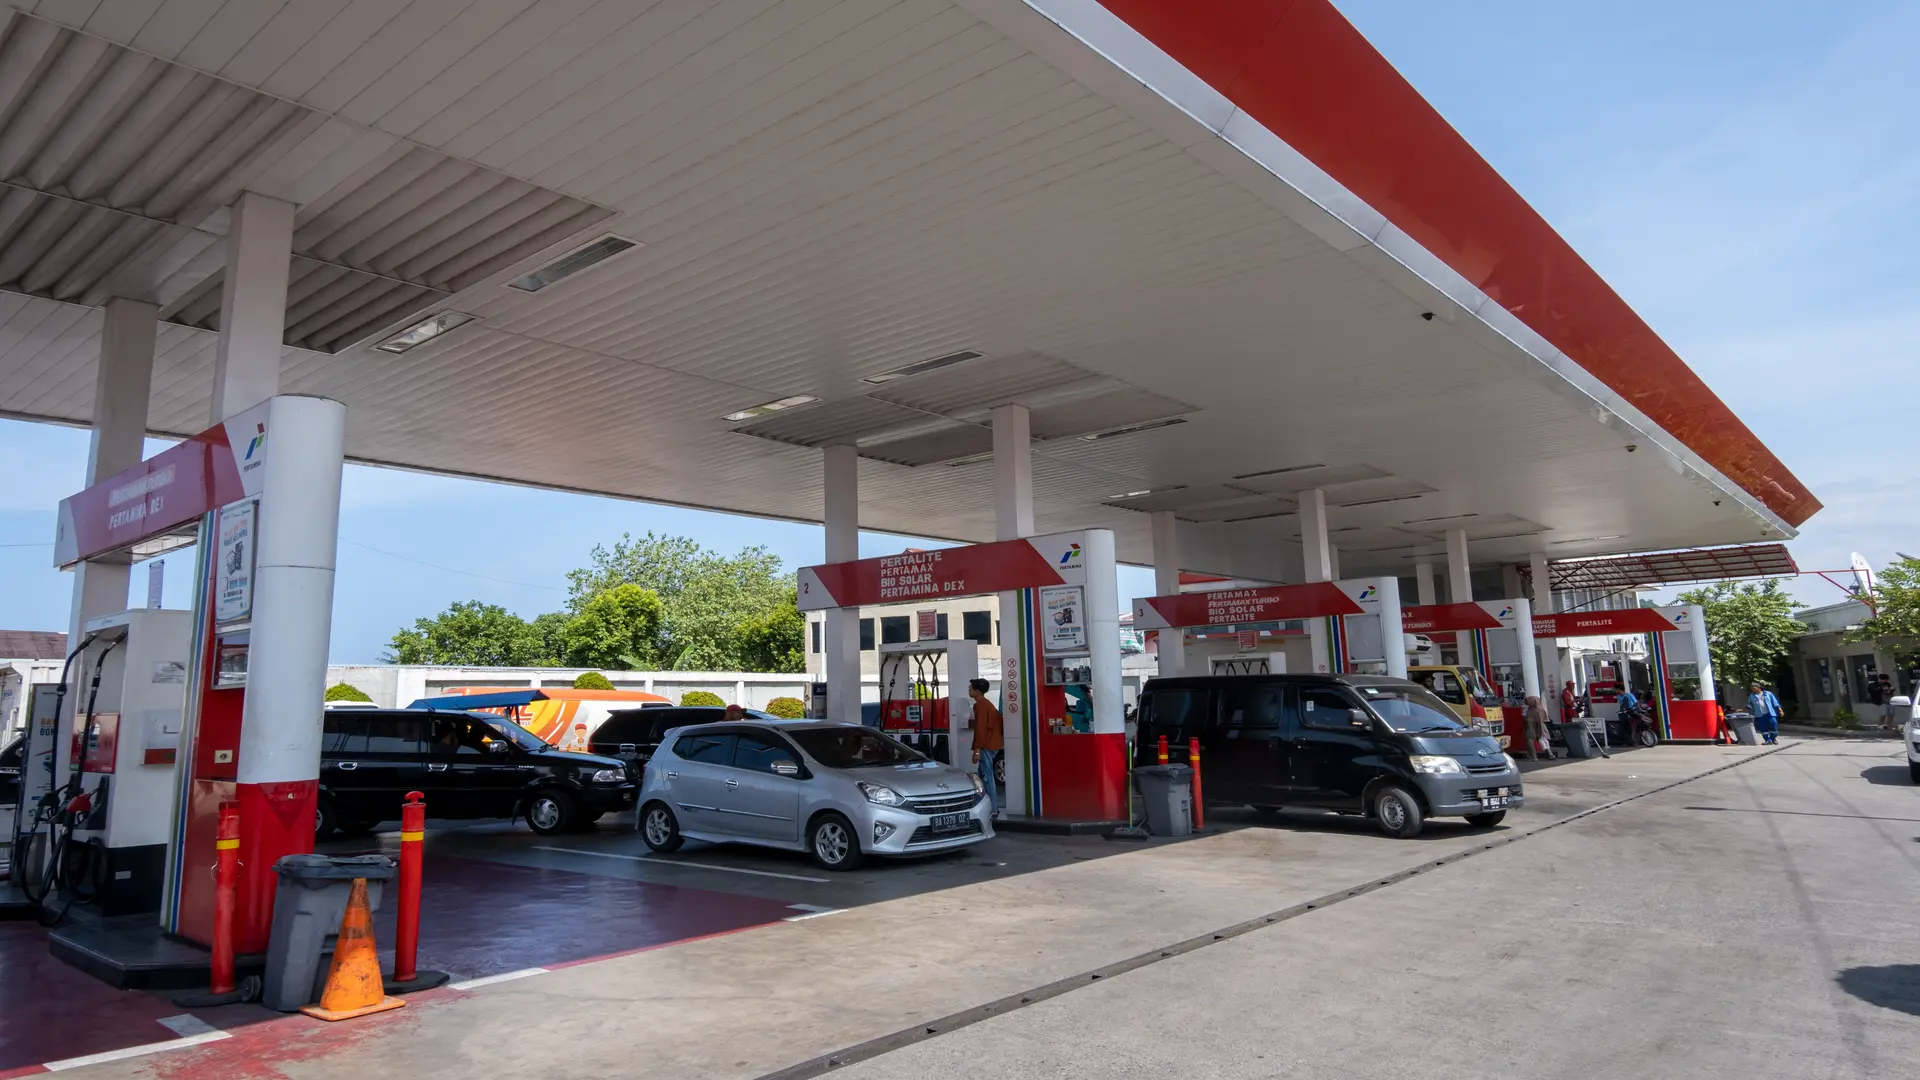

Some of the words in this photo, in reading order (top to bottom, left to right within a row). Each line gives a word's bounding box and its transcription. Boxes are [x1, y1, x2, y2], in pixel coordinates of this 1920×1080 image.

[880, 551, 942, 568] PERTALITE
[880, 563, 934, 577] PERTAMAX
[881, 577, 896, 588] BIO
[900, 573, 932, 585] SOLAR
[804, 582, 809, 594] 2
[881, 583, 939, 598] PERTAMINA
[944, 580, 965, 591] DEX
[1207, 590, 1258, 600] PERTAMAX
[1208, 598, 1250, 608] PERTAMAX
[1251, 596, 1280, 605] TURBO
[1138, 608, 1144, 617] 3
[1208, 608, 1225, 616] BIO
[1229, 604, 1264, 614] SOLAR
[1209, 613, 1255, 623] PERTALITE
[1577, 619, 1613, 627] PERTALITE
